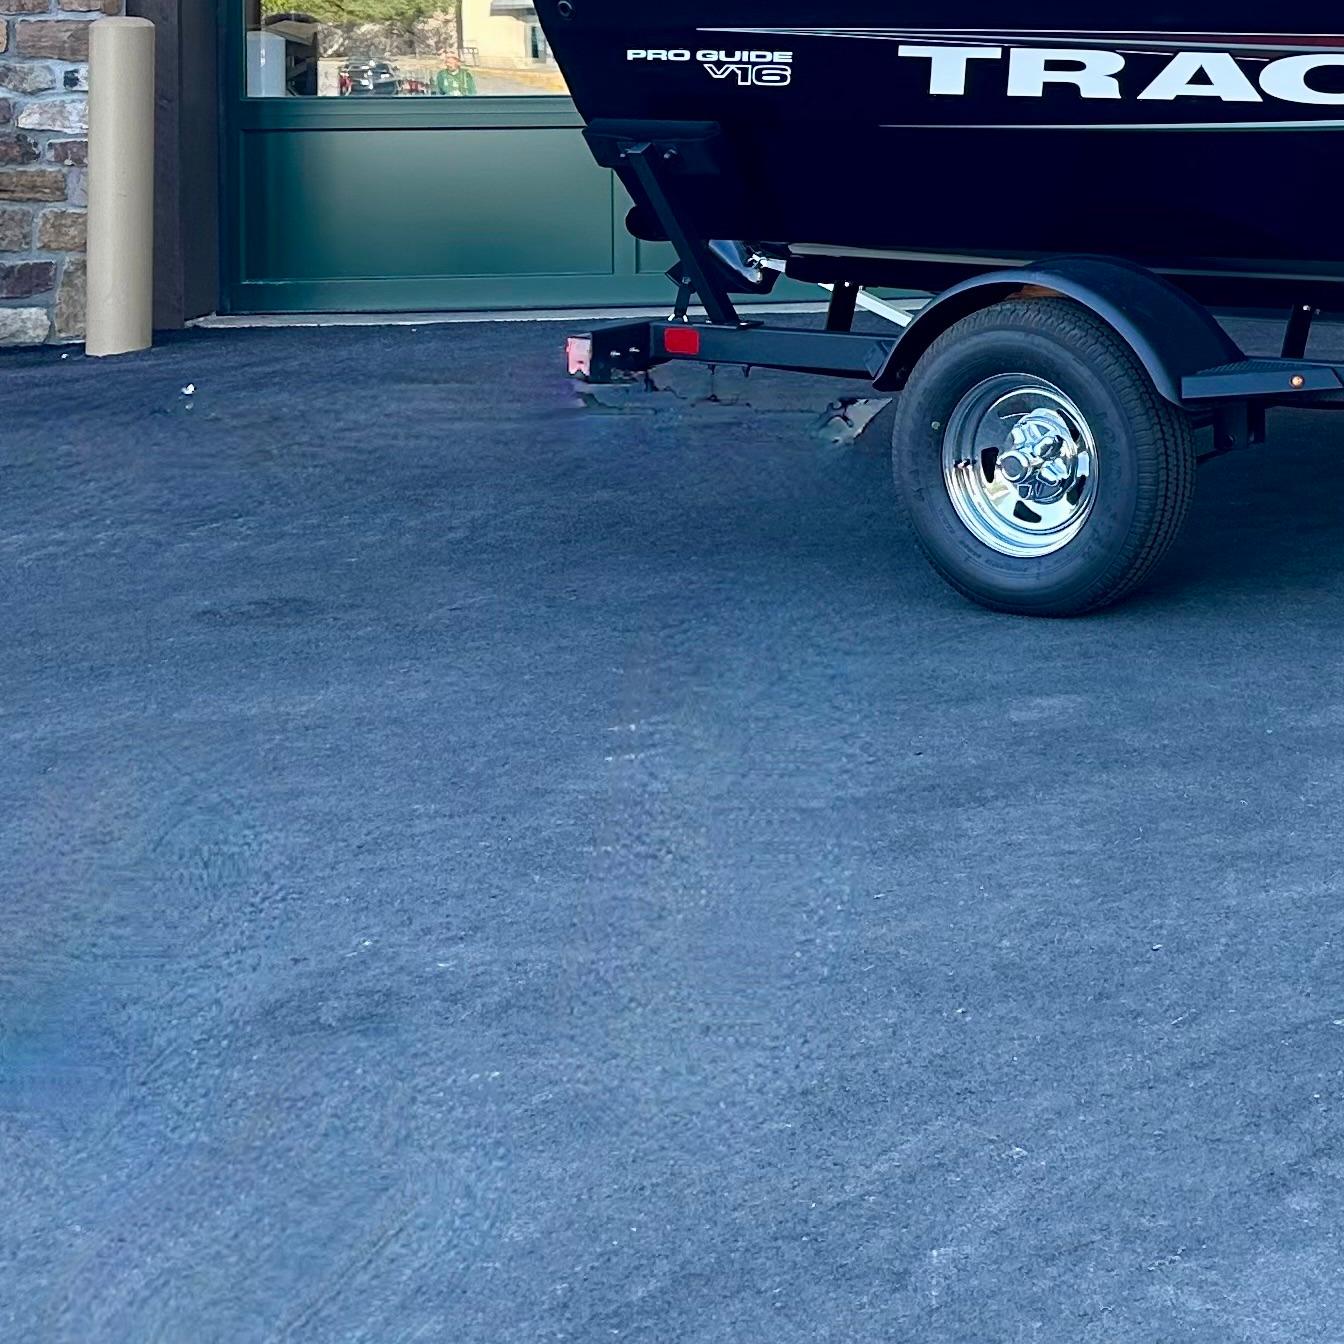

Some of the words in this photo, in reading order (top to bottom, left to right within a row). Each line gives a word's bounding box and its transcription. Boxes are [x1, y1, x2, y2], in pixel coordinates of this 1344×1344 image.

[626, 49, 691, 61] PRO
[695, 50, 793, 63] GUIDE
[703, 63, 792, 87] V16
